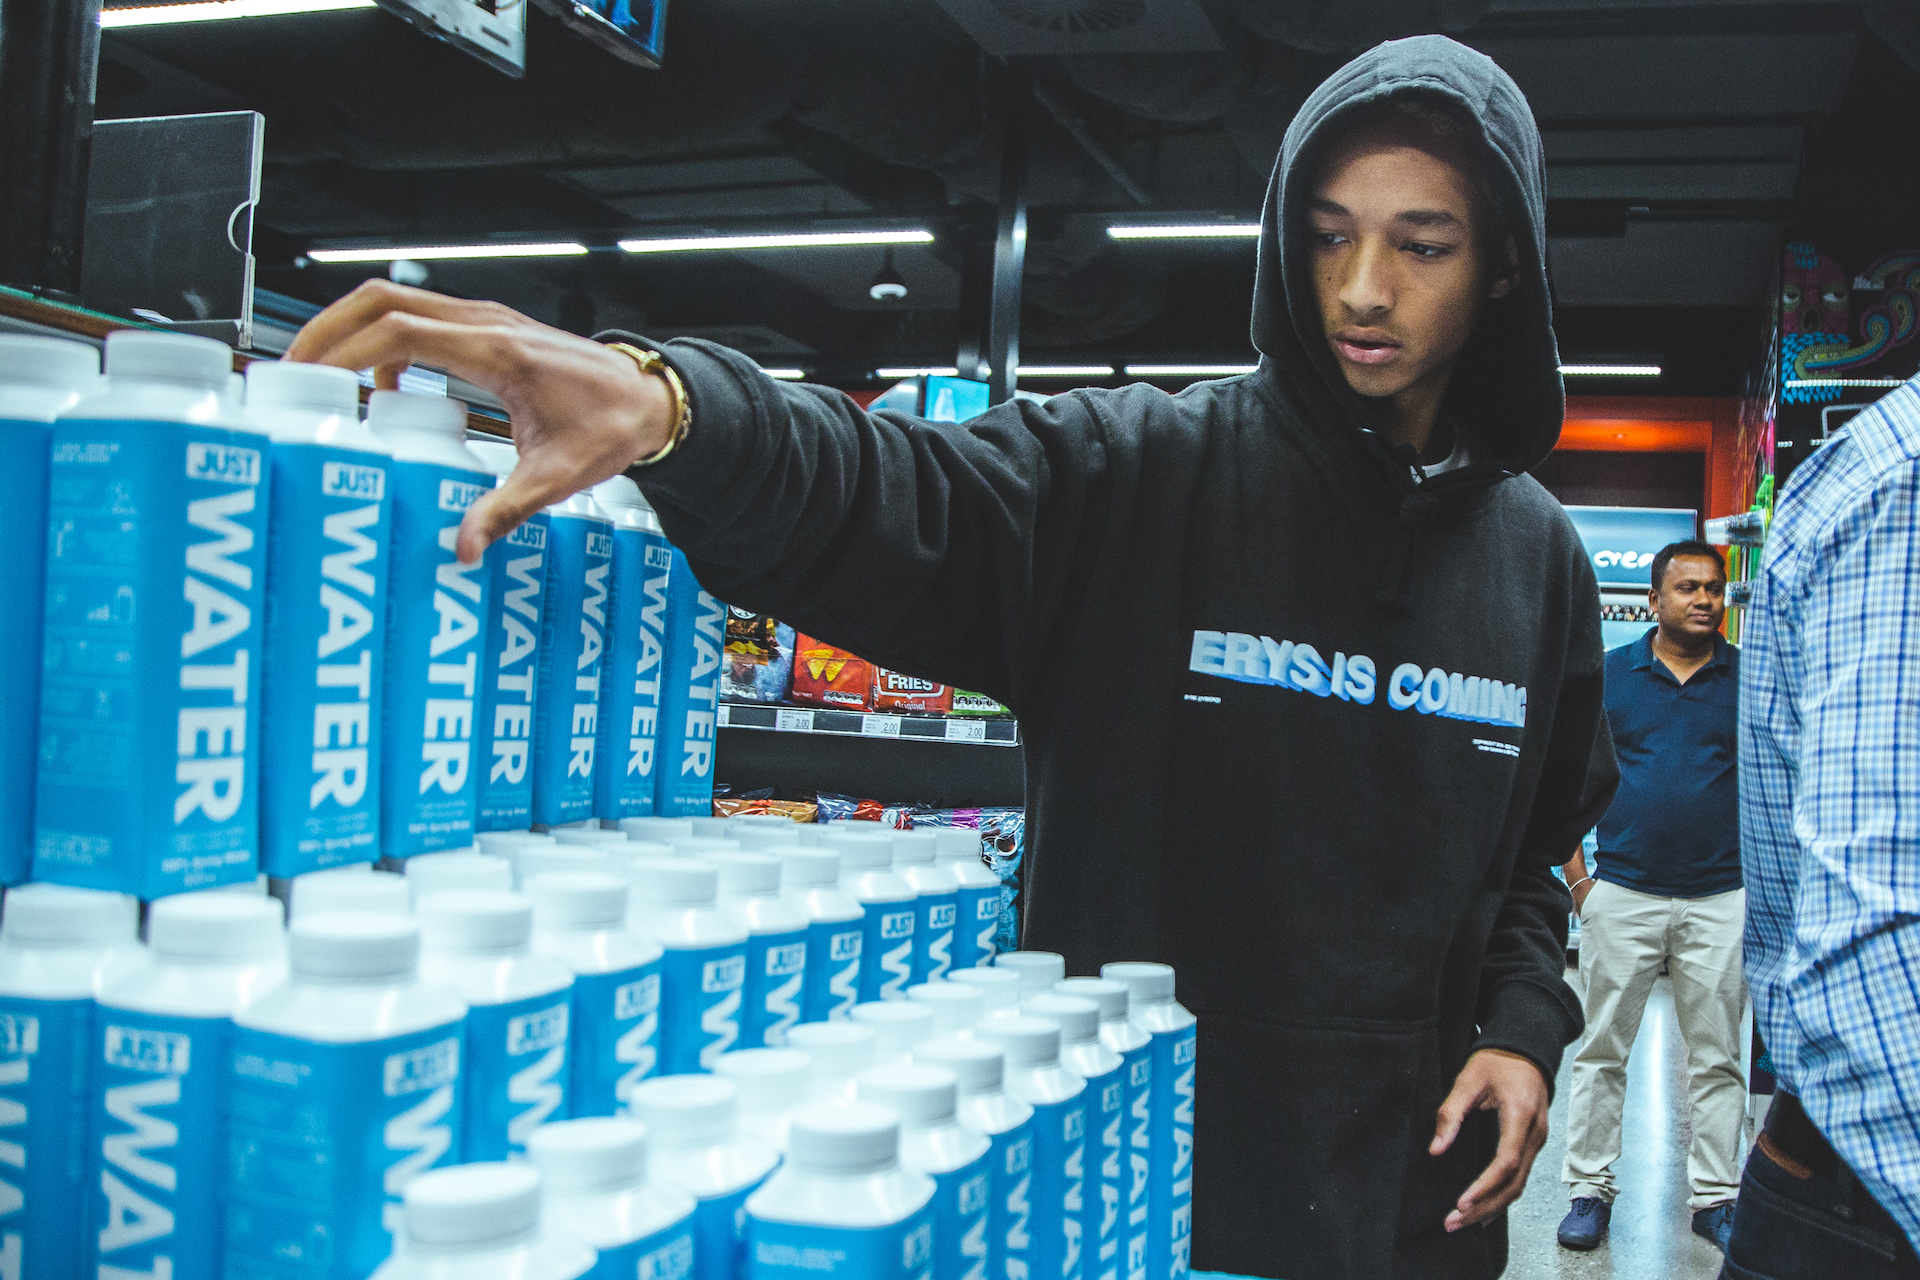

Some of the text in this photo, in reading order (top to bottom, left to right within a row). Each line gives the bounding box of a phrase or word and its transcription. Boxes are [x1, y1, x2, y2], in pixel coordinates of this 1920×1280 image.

[196, 446, 255, 483] JUST
[330, 466, 382, 497] JUST
[445, 481, 487, 508] JUS
[511, 523, 545, 549] JUST
[589, 534, 612, 556] JUST
[647, 547, 672, 567] JUST
[173, 488, 256, 826] WATER
[309, 503, 380, 811] WATER
[419, 526, 483, 796] WATER
[490, 552, 543, 785] WATER
[567, 563, 610, 779] WATER
[1189, 629, 1331, 698] ERYS
[1331, 651, 1377, 705] IS
[626, 574, 669, 778] WATER
[681, 591, 724, 779] WATER
[887, 674, 934, 692] FRIES
[894, 699, 926, 711] Original
[883, 722, 899, 733] 2.00
[967, 727, 983, 737] 2.00
[1169, 1062, 1197, 1280] WATER
